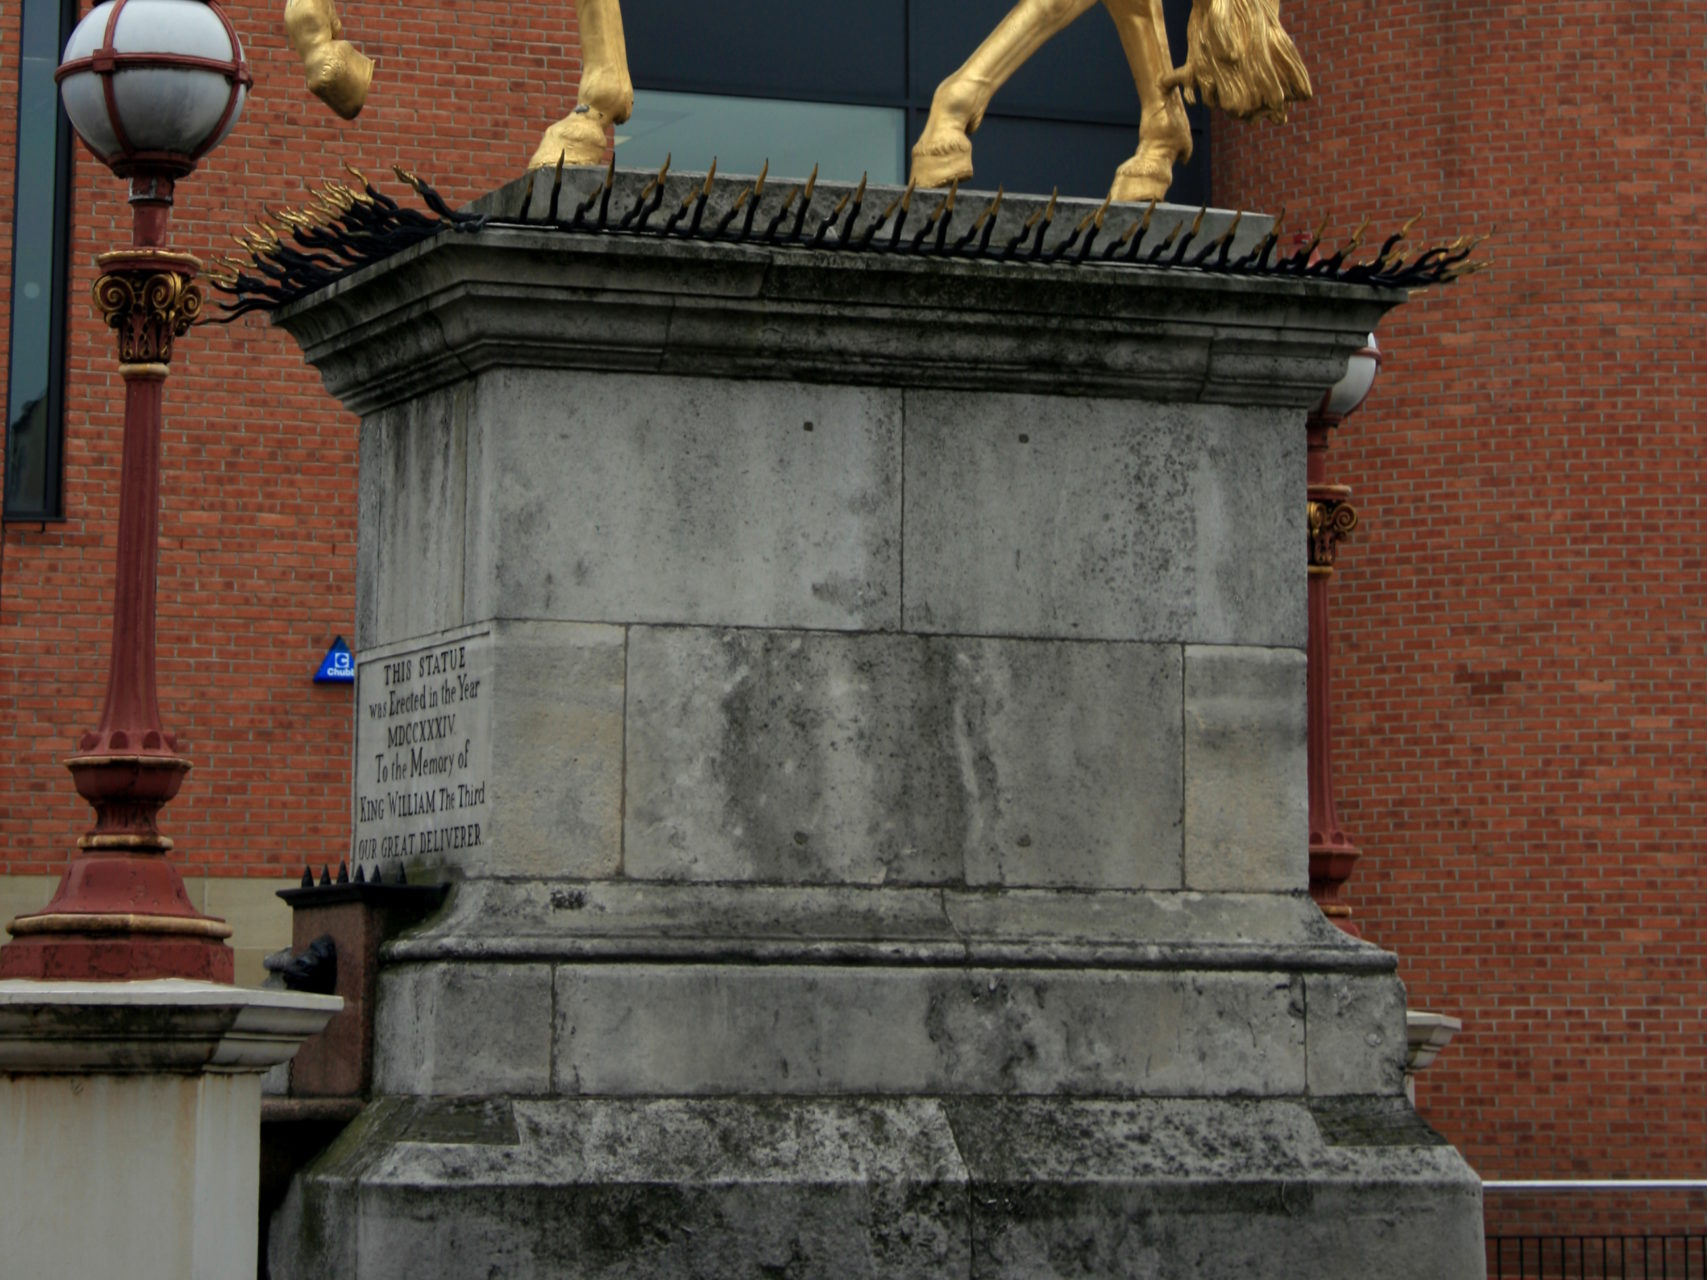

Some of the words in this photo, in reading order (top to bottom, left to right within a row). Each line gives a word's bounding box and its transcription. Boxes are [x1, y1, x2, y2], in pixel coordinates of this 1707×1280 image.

[384, 660, 412, 686] THIS
[419, 646, 466, 678] STATUE
[369, 701, 387, 719] was
[389, 685, 426, 717] Erected
[429, 686, 438, 708] in
[441, 678, 457, 705] the
[457, 673, 480, 701] Year
[375, 753, 388, 783] To
[391, 751, 408, 781] the
[410, 746, 454, 778] Memory
[458, 738, 471, 769] of
[360, 795, 385, 822] KING
[387, 789, 436, 818] WILLIAM
[439, 786, 455, 812] The
[458, 780, 485, 809] Third
[358, 838, 377, 860] OUR
[381, 833, 416, 859] GREAT
